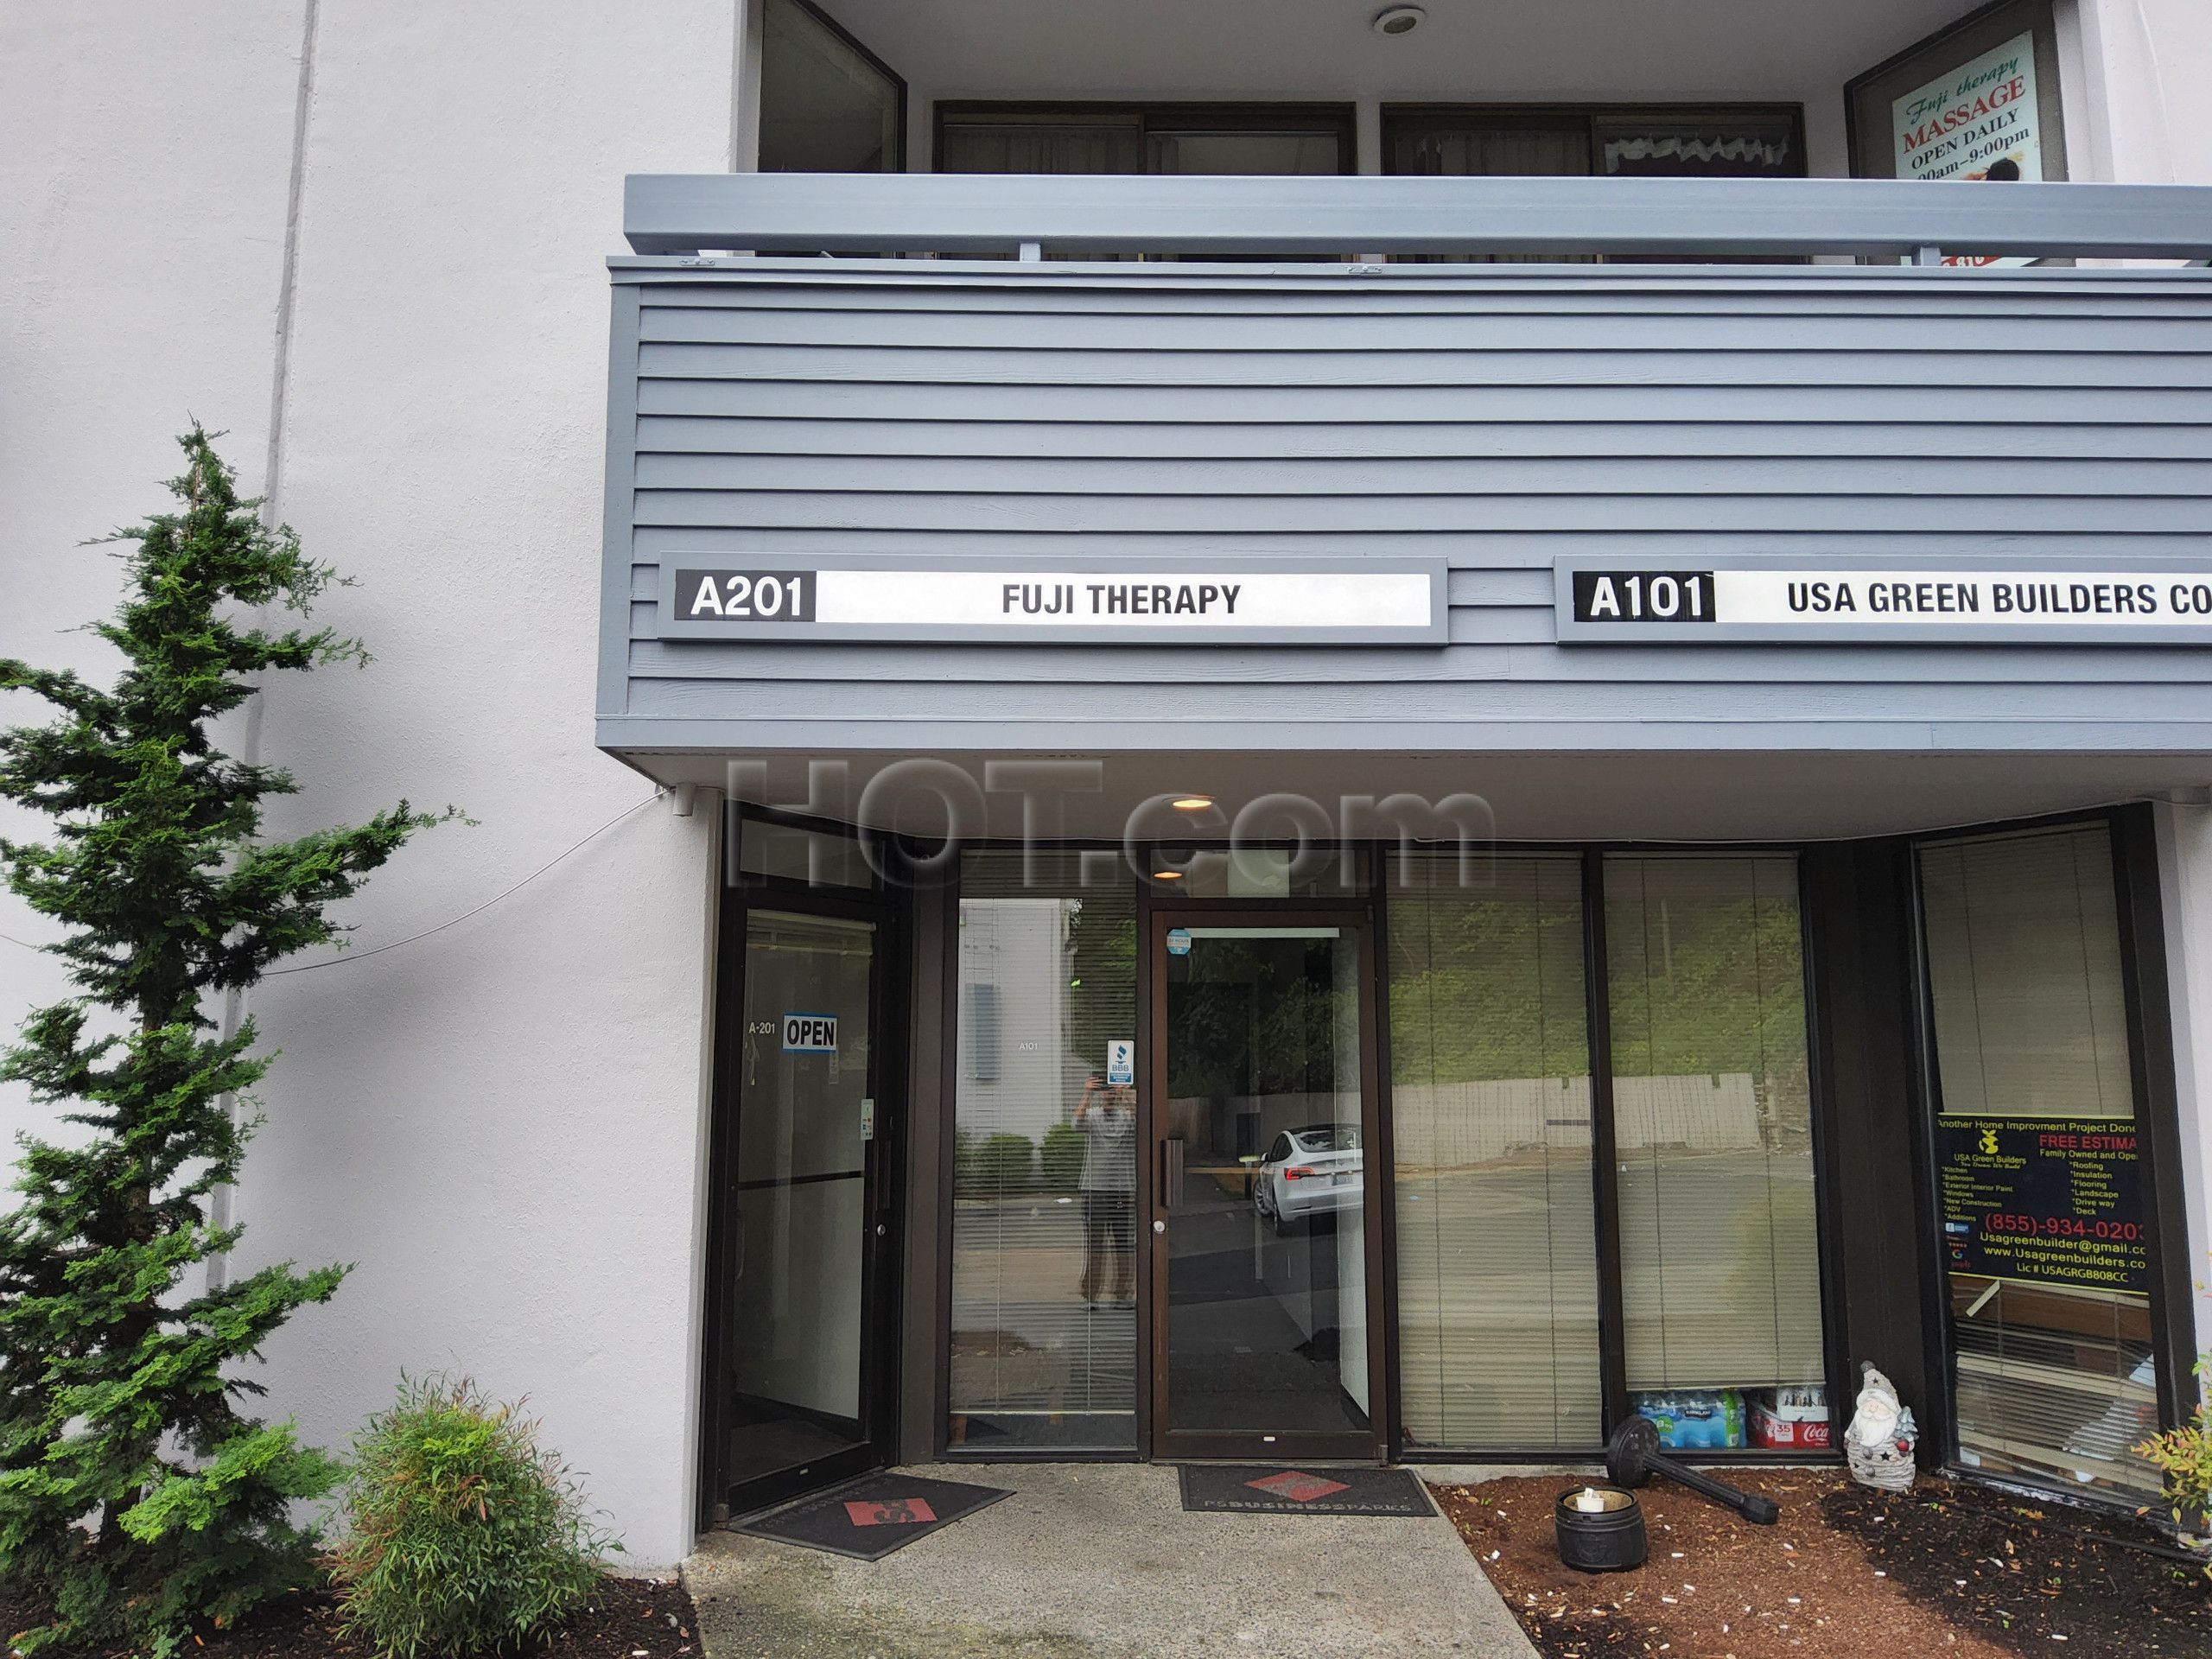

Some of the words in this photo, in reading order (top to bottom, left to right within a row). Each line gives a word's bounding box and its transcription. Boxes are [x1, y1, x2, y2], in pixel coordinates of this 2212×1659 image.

[1906, 90, 1948, 124] Fuji
[1956, 57, 2018, 96] therapy
[1903, 74, 2025, 154] MASSAGE
[1911, 137, 1959, 169] OPEN
[1962, 107, 2018, 145] DAILY
[691, 575, 800, 616] A201
[1004, 586, 1072, 613] FUJI
[1087, 586, 1240, 613] THERAPY
[1591, 576, 1702, 617] A101
[1789, 583, 1856, 612] USA
[1869, 583, 1979, 612] GREEN
[1993, 584, 2157, 613] BUILDERS
[2171, 585, 2212, 613] CO
[748, 1021, 775, 1034] A-201
[786, 1020, 835, 1046] OPEN
[1975, 1121, 2004, 1129] Home
[2006, 1121, 2066, 1131] Improvment
[2069, 1122, 2107, 1134] Project
[2039, 1134, 2077, 1148] FREE
[2040, 1148, 2066, 1160] Family
[2069, 1150, 2097, 1159] Owned
[1996, 1155, 2026, 1164] Builders
[2017, 1262, 2031, 1273] Lic
[2042, 1265, 2129, 1282] USAGRGB808CC
[1777, 1424, 1790, 1433] 35
